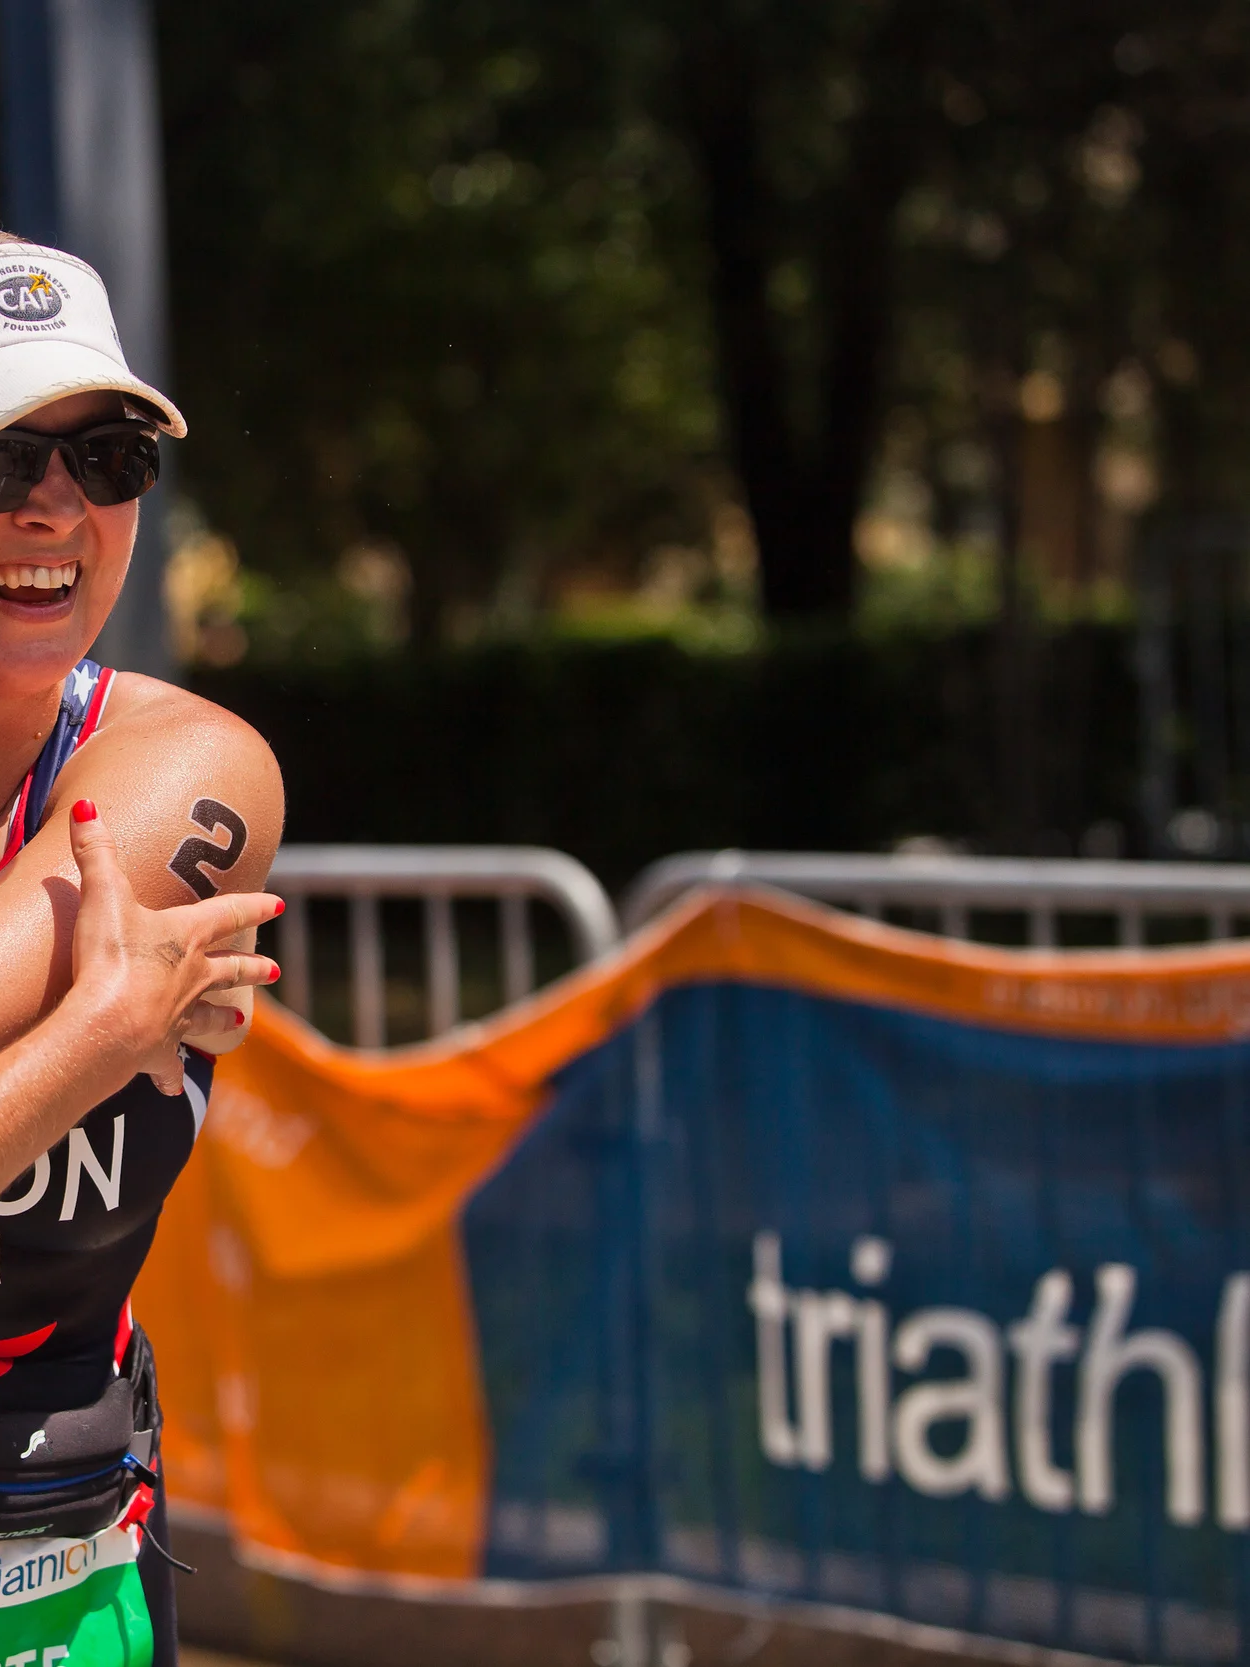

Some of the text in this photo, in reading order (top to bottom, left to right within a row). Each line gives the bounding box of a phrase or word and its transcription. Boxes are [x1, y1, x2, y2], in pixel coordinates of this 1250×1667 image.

[28, 265, 71, 300] ATHLETES
[3, 319, 67, 332] FOUNDATION
[168, 796, 248, 900] 2
